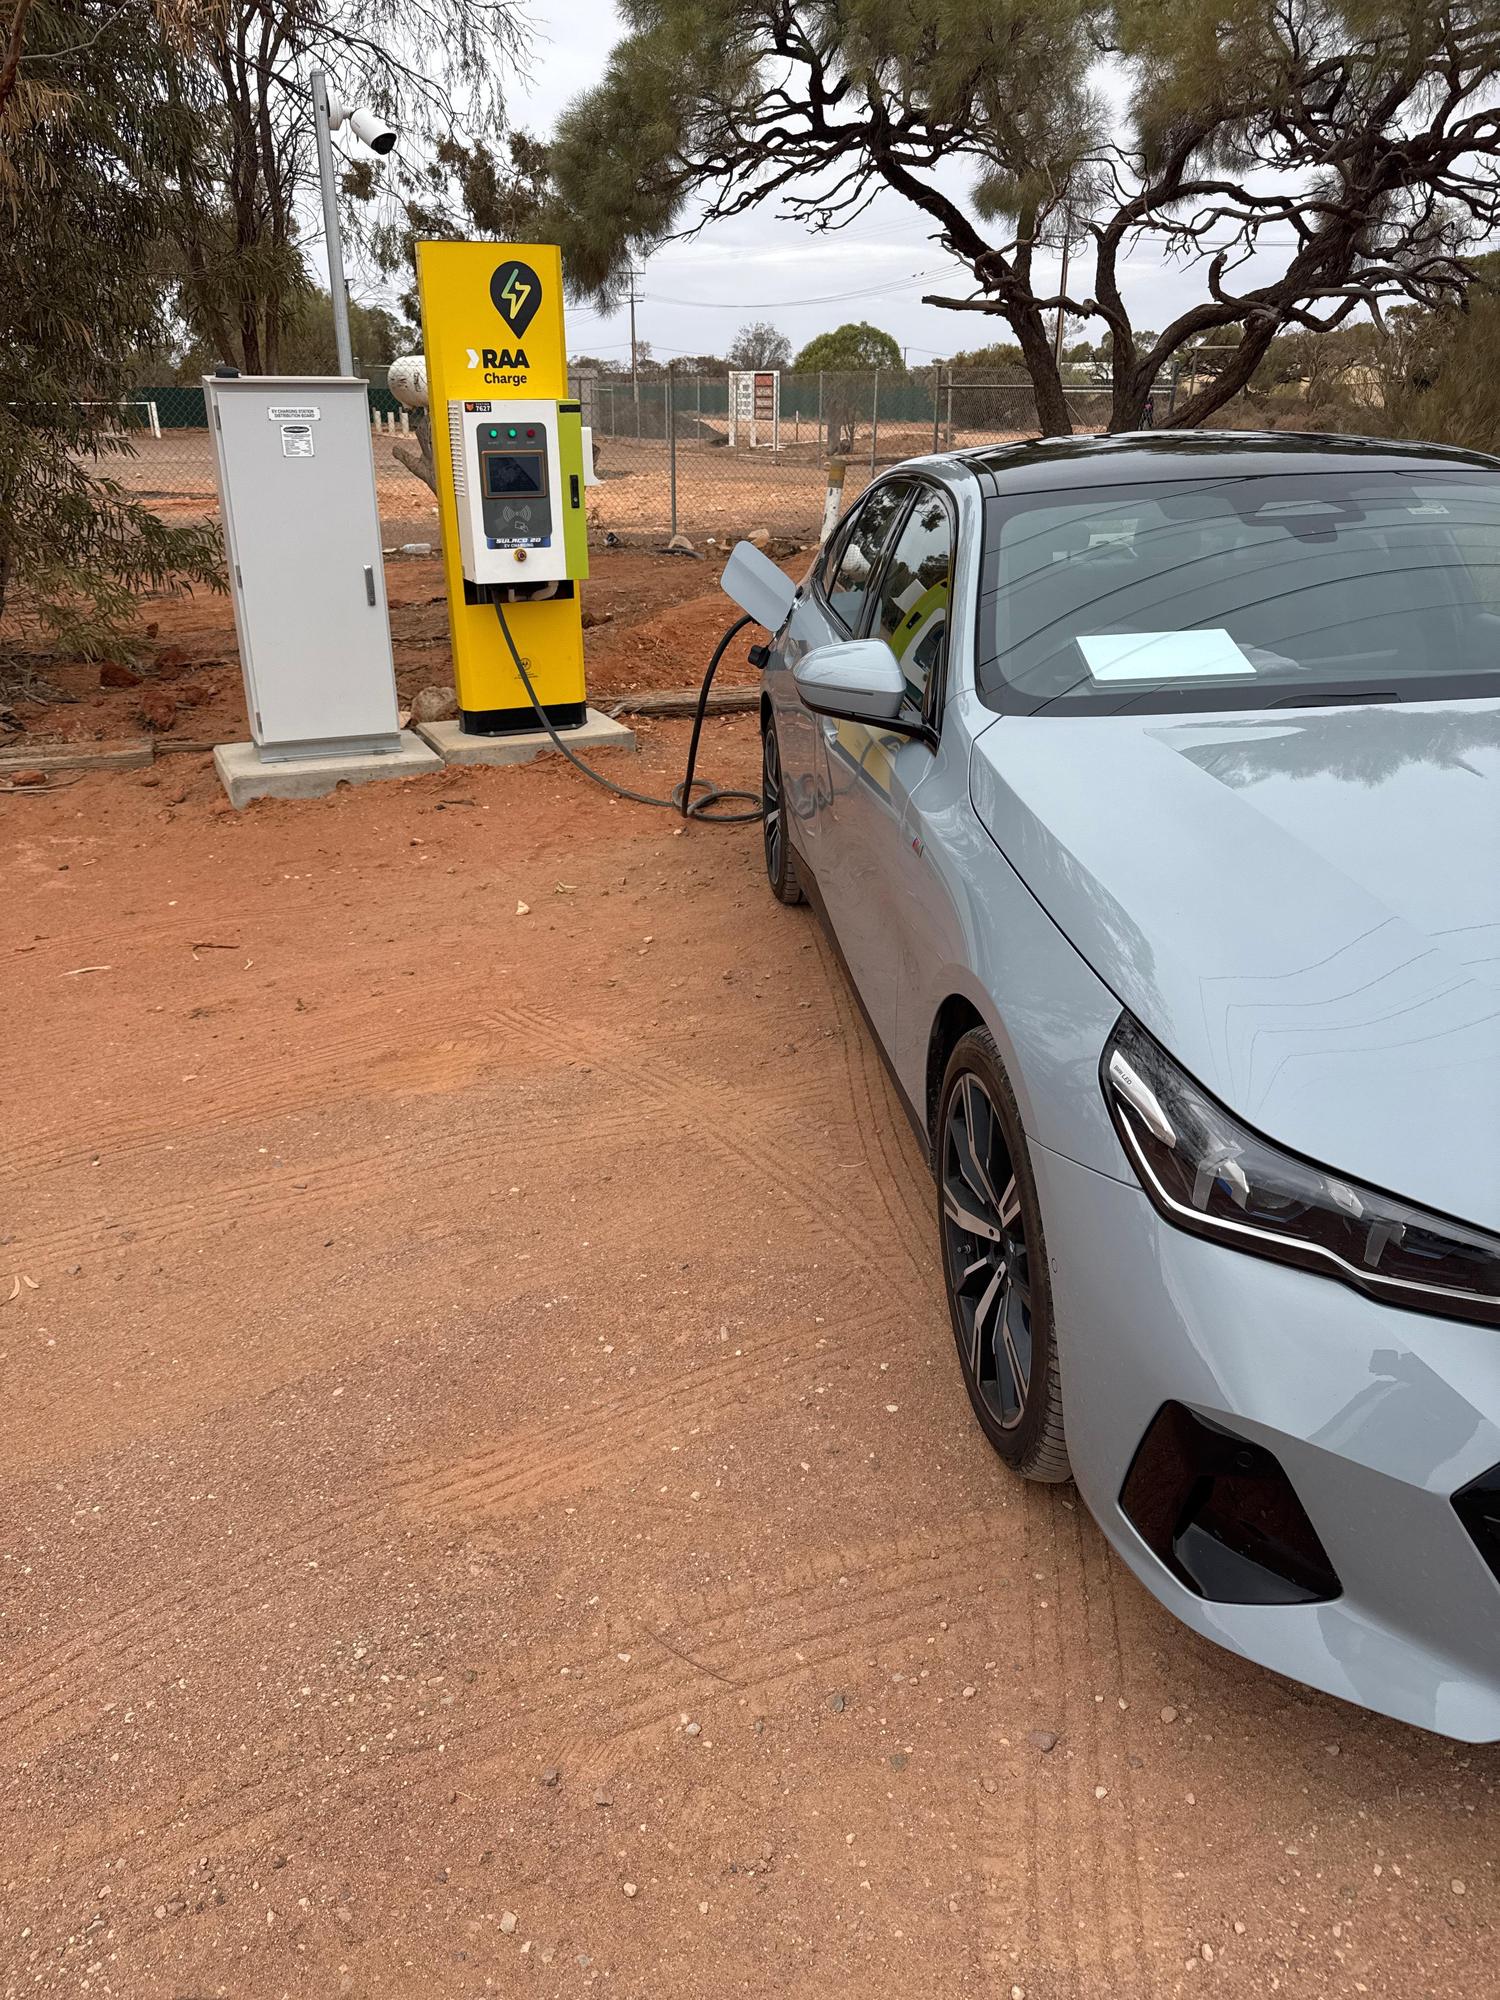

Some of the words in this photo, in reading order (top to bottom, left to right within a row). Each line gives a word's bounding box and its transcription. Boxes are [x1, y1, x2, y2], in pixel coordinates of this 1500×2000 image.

[481, 348, 530, 369] RAA
[484, 372, 527, 387] Charge
[1122, 1074, 1131, 1084] LED
